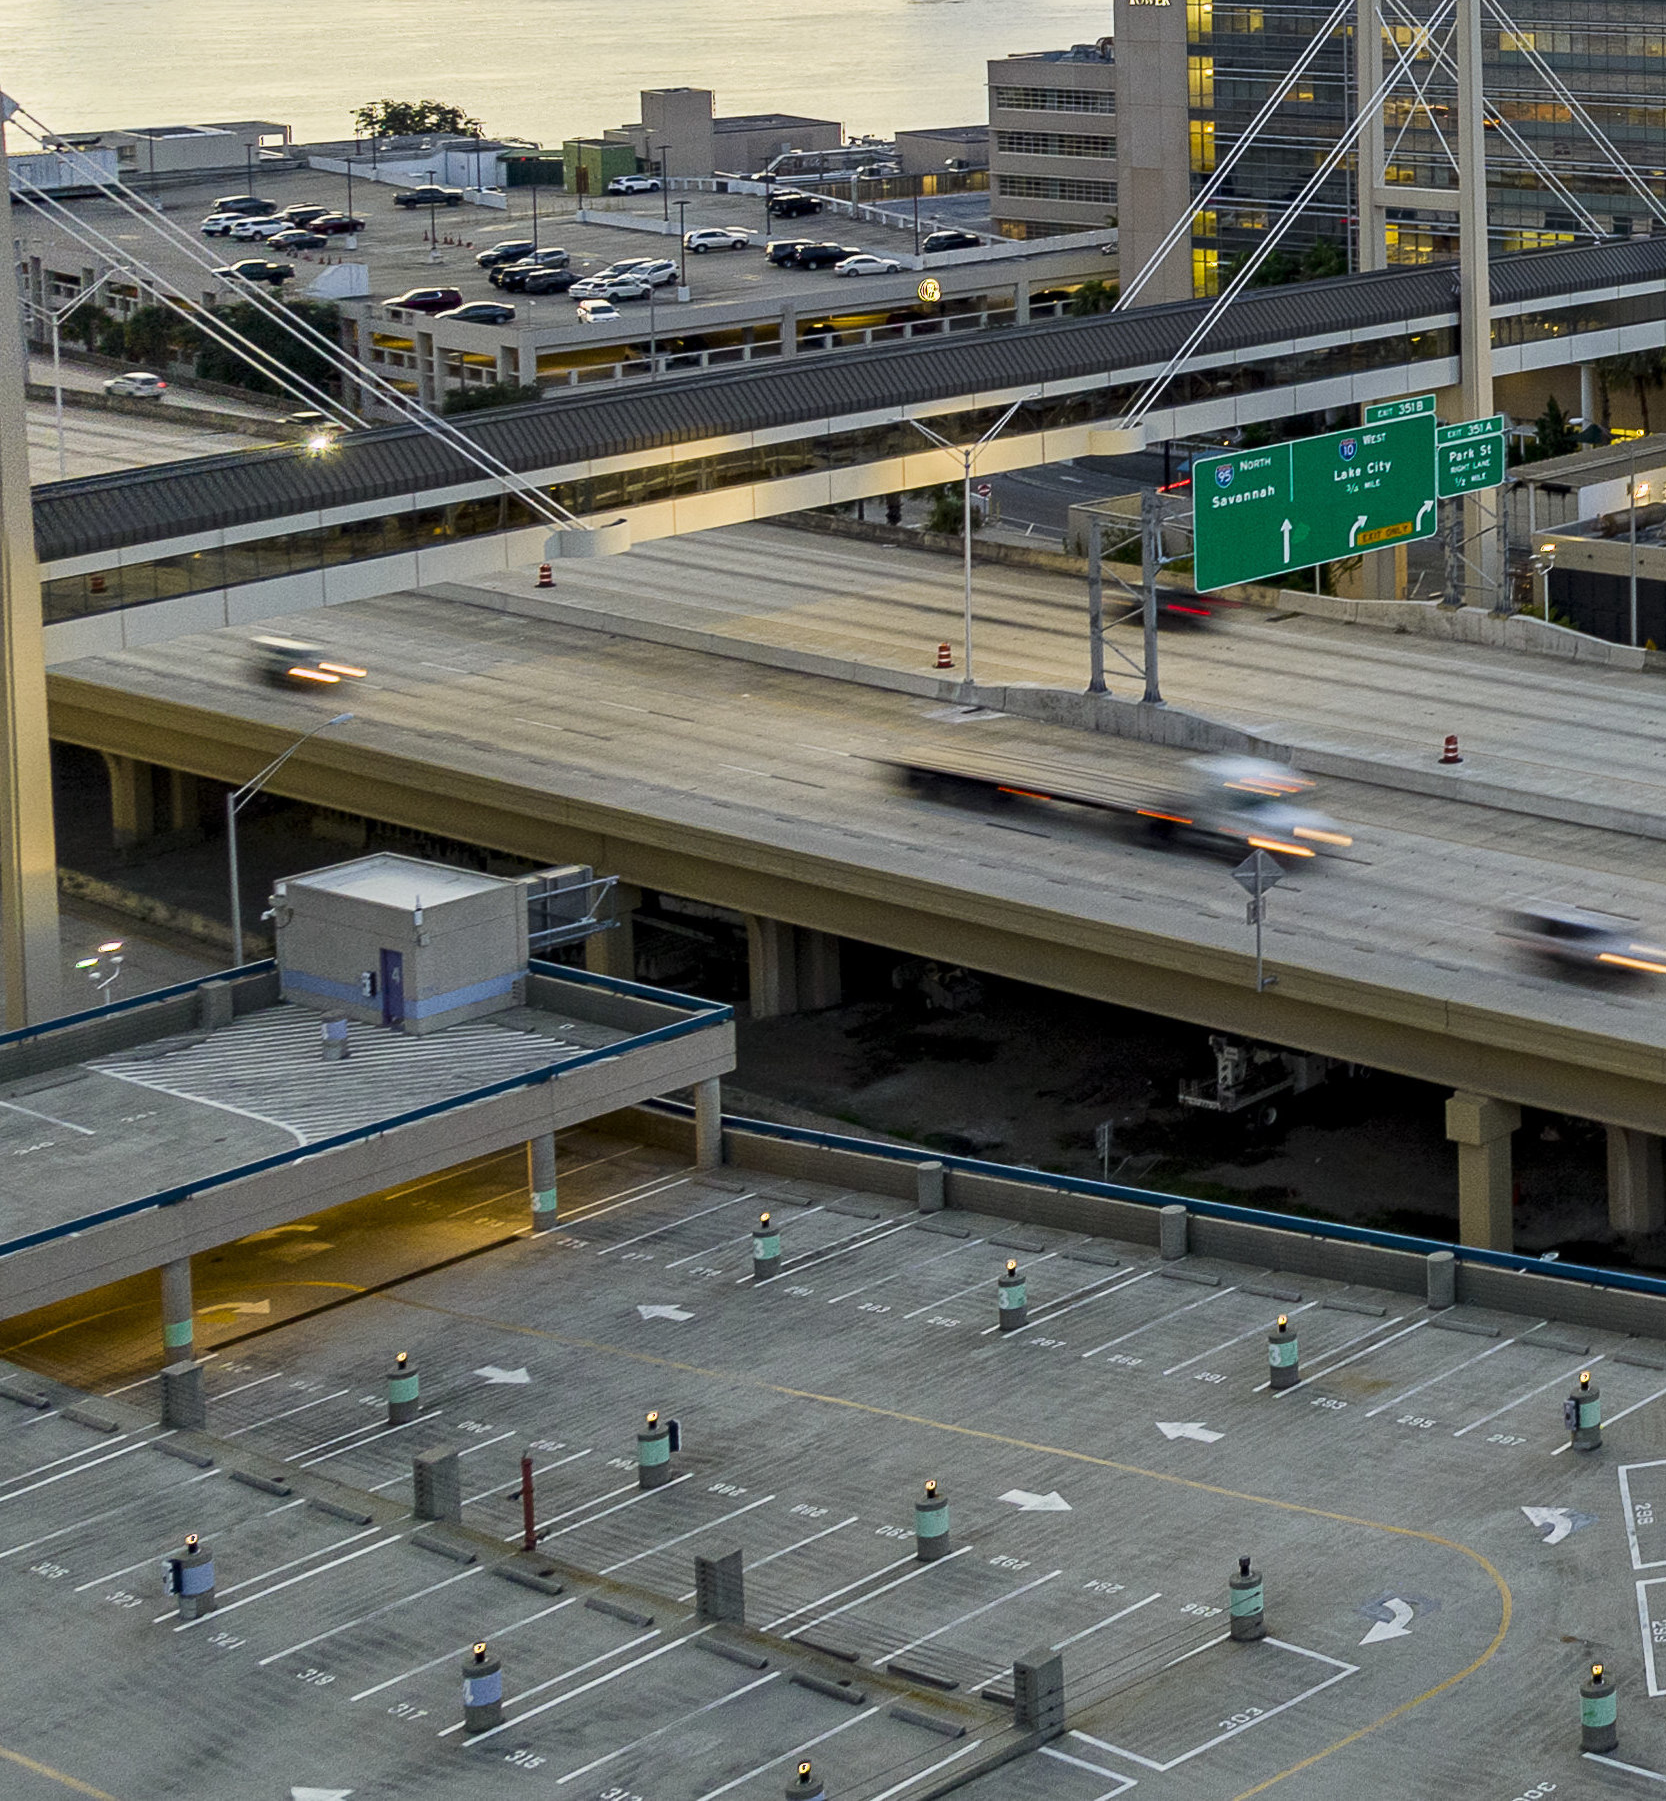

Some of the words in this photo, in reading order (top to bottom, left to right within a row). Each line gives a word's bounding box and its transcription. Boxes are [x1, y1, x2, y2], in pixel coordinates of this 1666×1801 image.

[1362, 432, 1387, 446] WEST
[1342, 443, 1354, 457] 10
[1449, 448, 1476, 463] Park
[1479, 444, 1492, 457] St
[1239, 457, 1272, 472] NORTH
[1333, 467, 1362, 482] Lake
[1366, 459, 1393, 476] City
[1450, 463, 1471, 475] RIGHT
[1472, 459, 1492, 470] LANE
[1217, 470, 1232, 484] 95
[1211, 486, 1276, 509] Savannah
[1361, 529, 1382, 544] EXIT
[1384, 524, 1410, 539] ONLY
[753, 1238, 764, 1258] 3
[998, 1289, 1010, 1309] 3
[1269, 1343, 1281, 1367] 3
[1309, 1396, 1348, 1411] 293
[1396, 1414, 1437, 1429] 295
[874, 1524, 917, 1541] 290
[1179, 1601, 1224, 1618] 296
[207, 1631, 247, 1650] 321
[297, 1667, 337, 1687] 319
[387, 1702, 429, 1722] 317
[1218, 1706, 1265, 1732] 303
[504, 1749, 548, 1771] 315
[1511, 1781, 1558, 1801] 30
